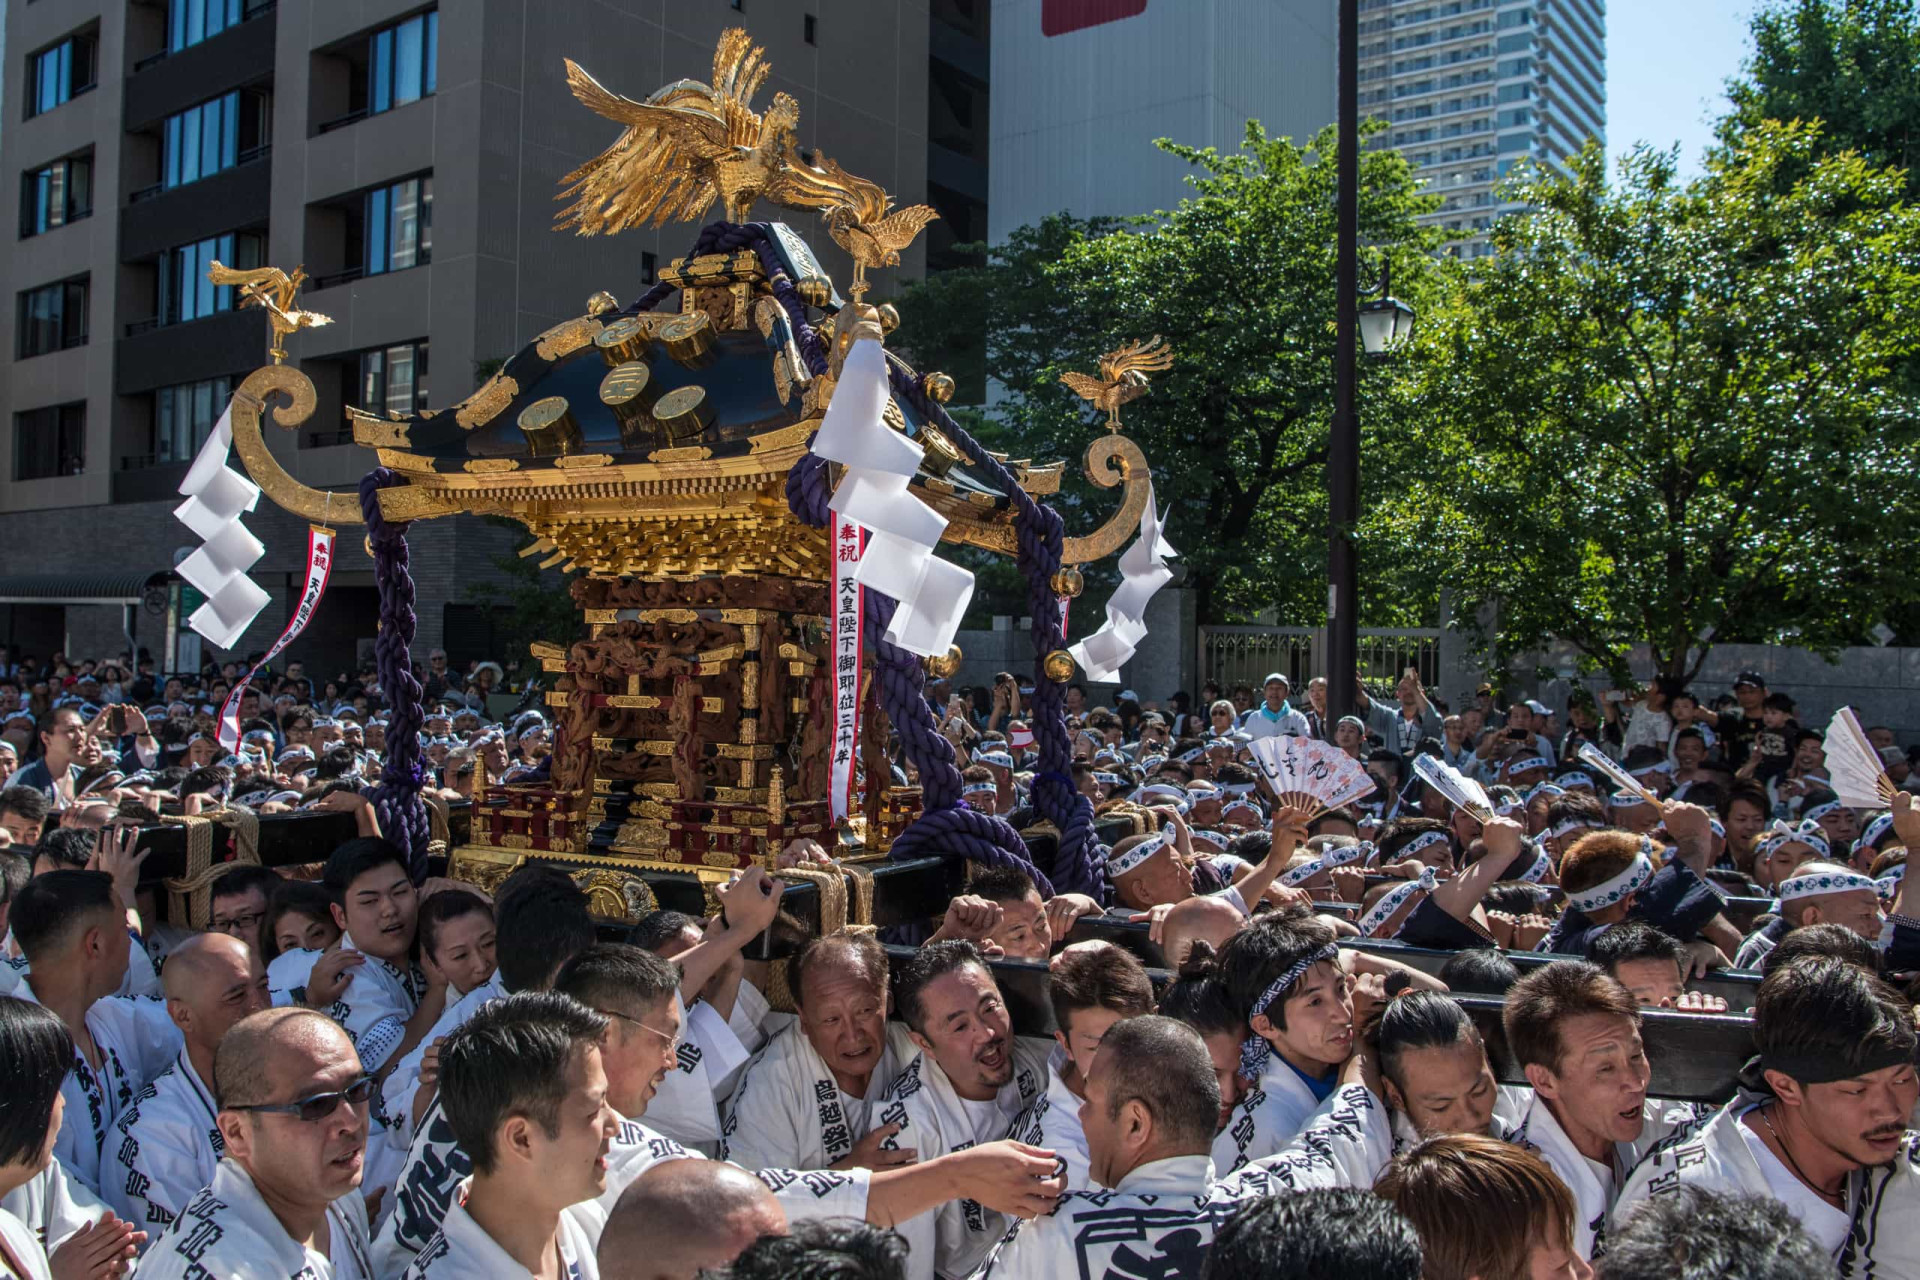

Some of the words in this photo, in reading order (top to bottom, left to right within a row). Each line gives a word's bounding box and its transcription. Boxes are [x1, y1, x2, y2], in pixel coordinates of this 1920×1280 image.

[838, 523, 858, 563] 奉祝
[833, 576, 858, 766] 天皇陛下御即位三十年
